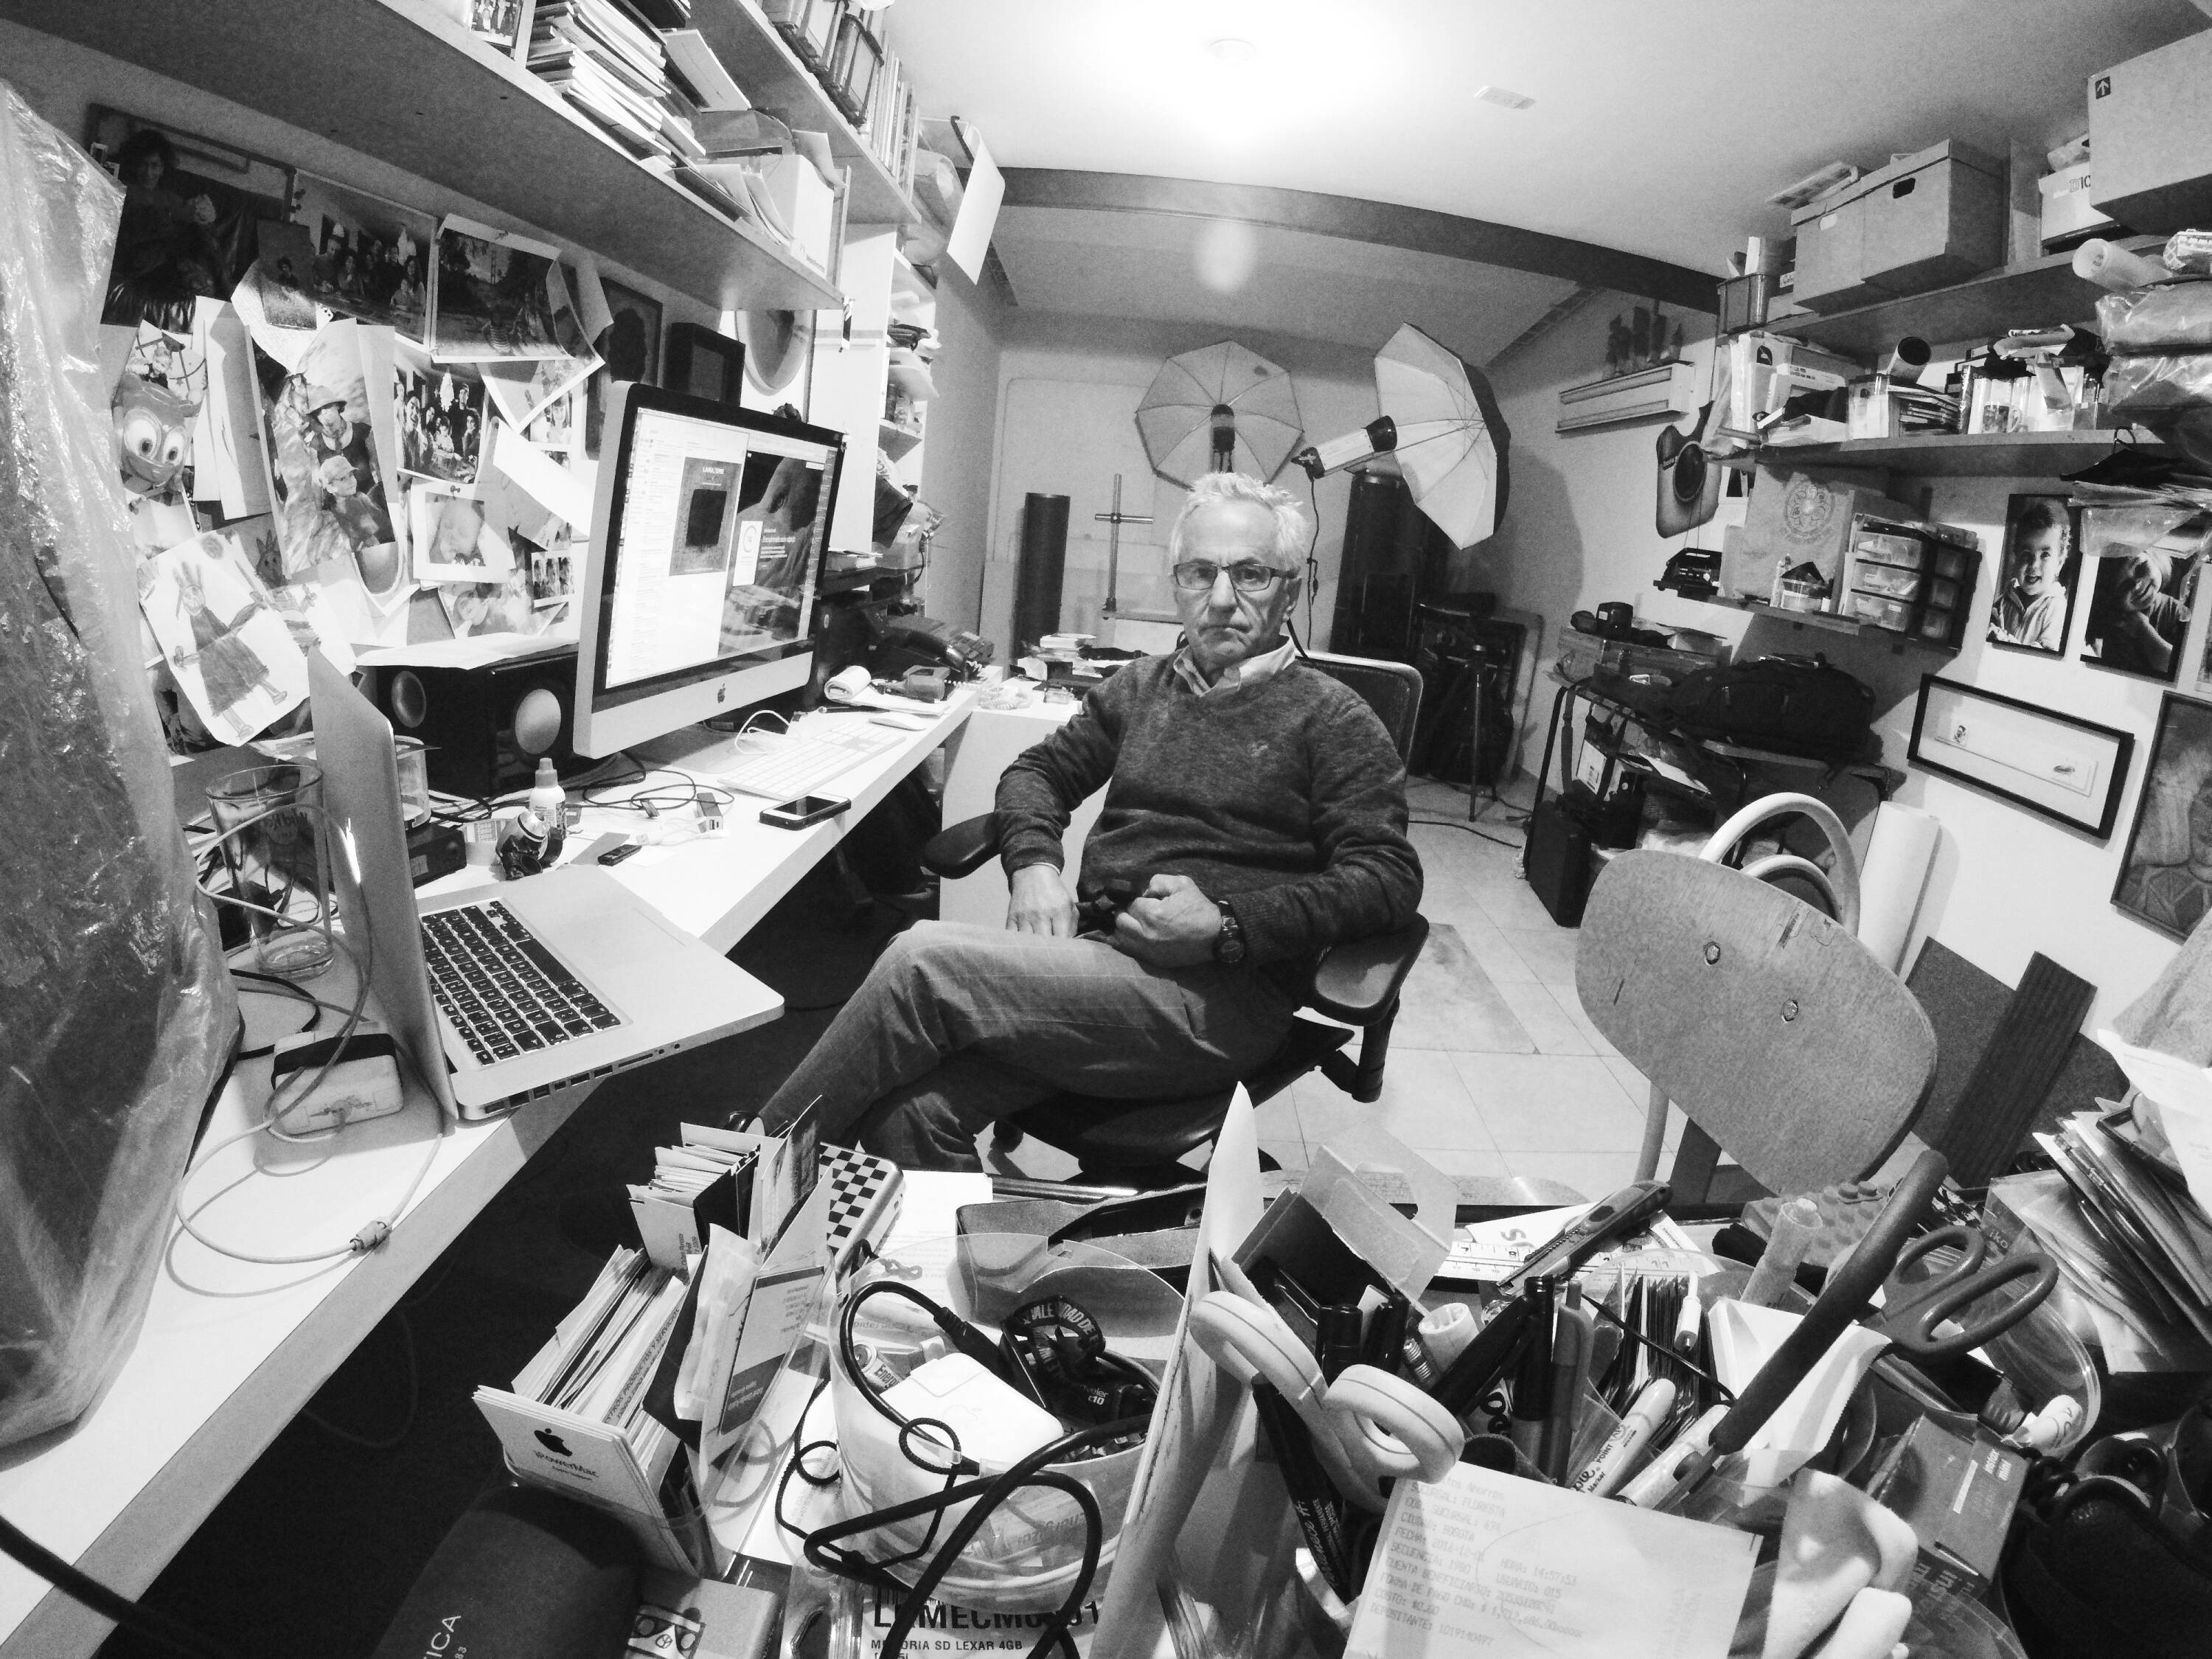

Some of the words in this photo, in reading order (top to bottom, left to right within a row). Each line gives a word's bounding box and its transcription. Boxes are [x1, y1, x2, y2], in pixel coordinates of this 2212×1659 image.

[935, 1641, 950, 1651] SD
[956, 1641, 995, 1651] LEXAR
[998, 1641, 1023, 1650] 4GB
